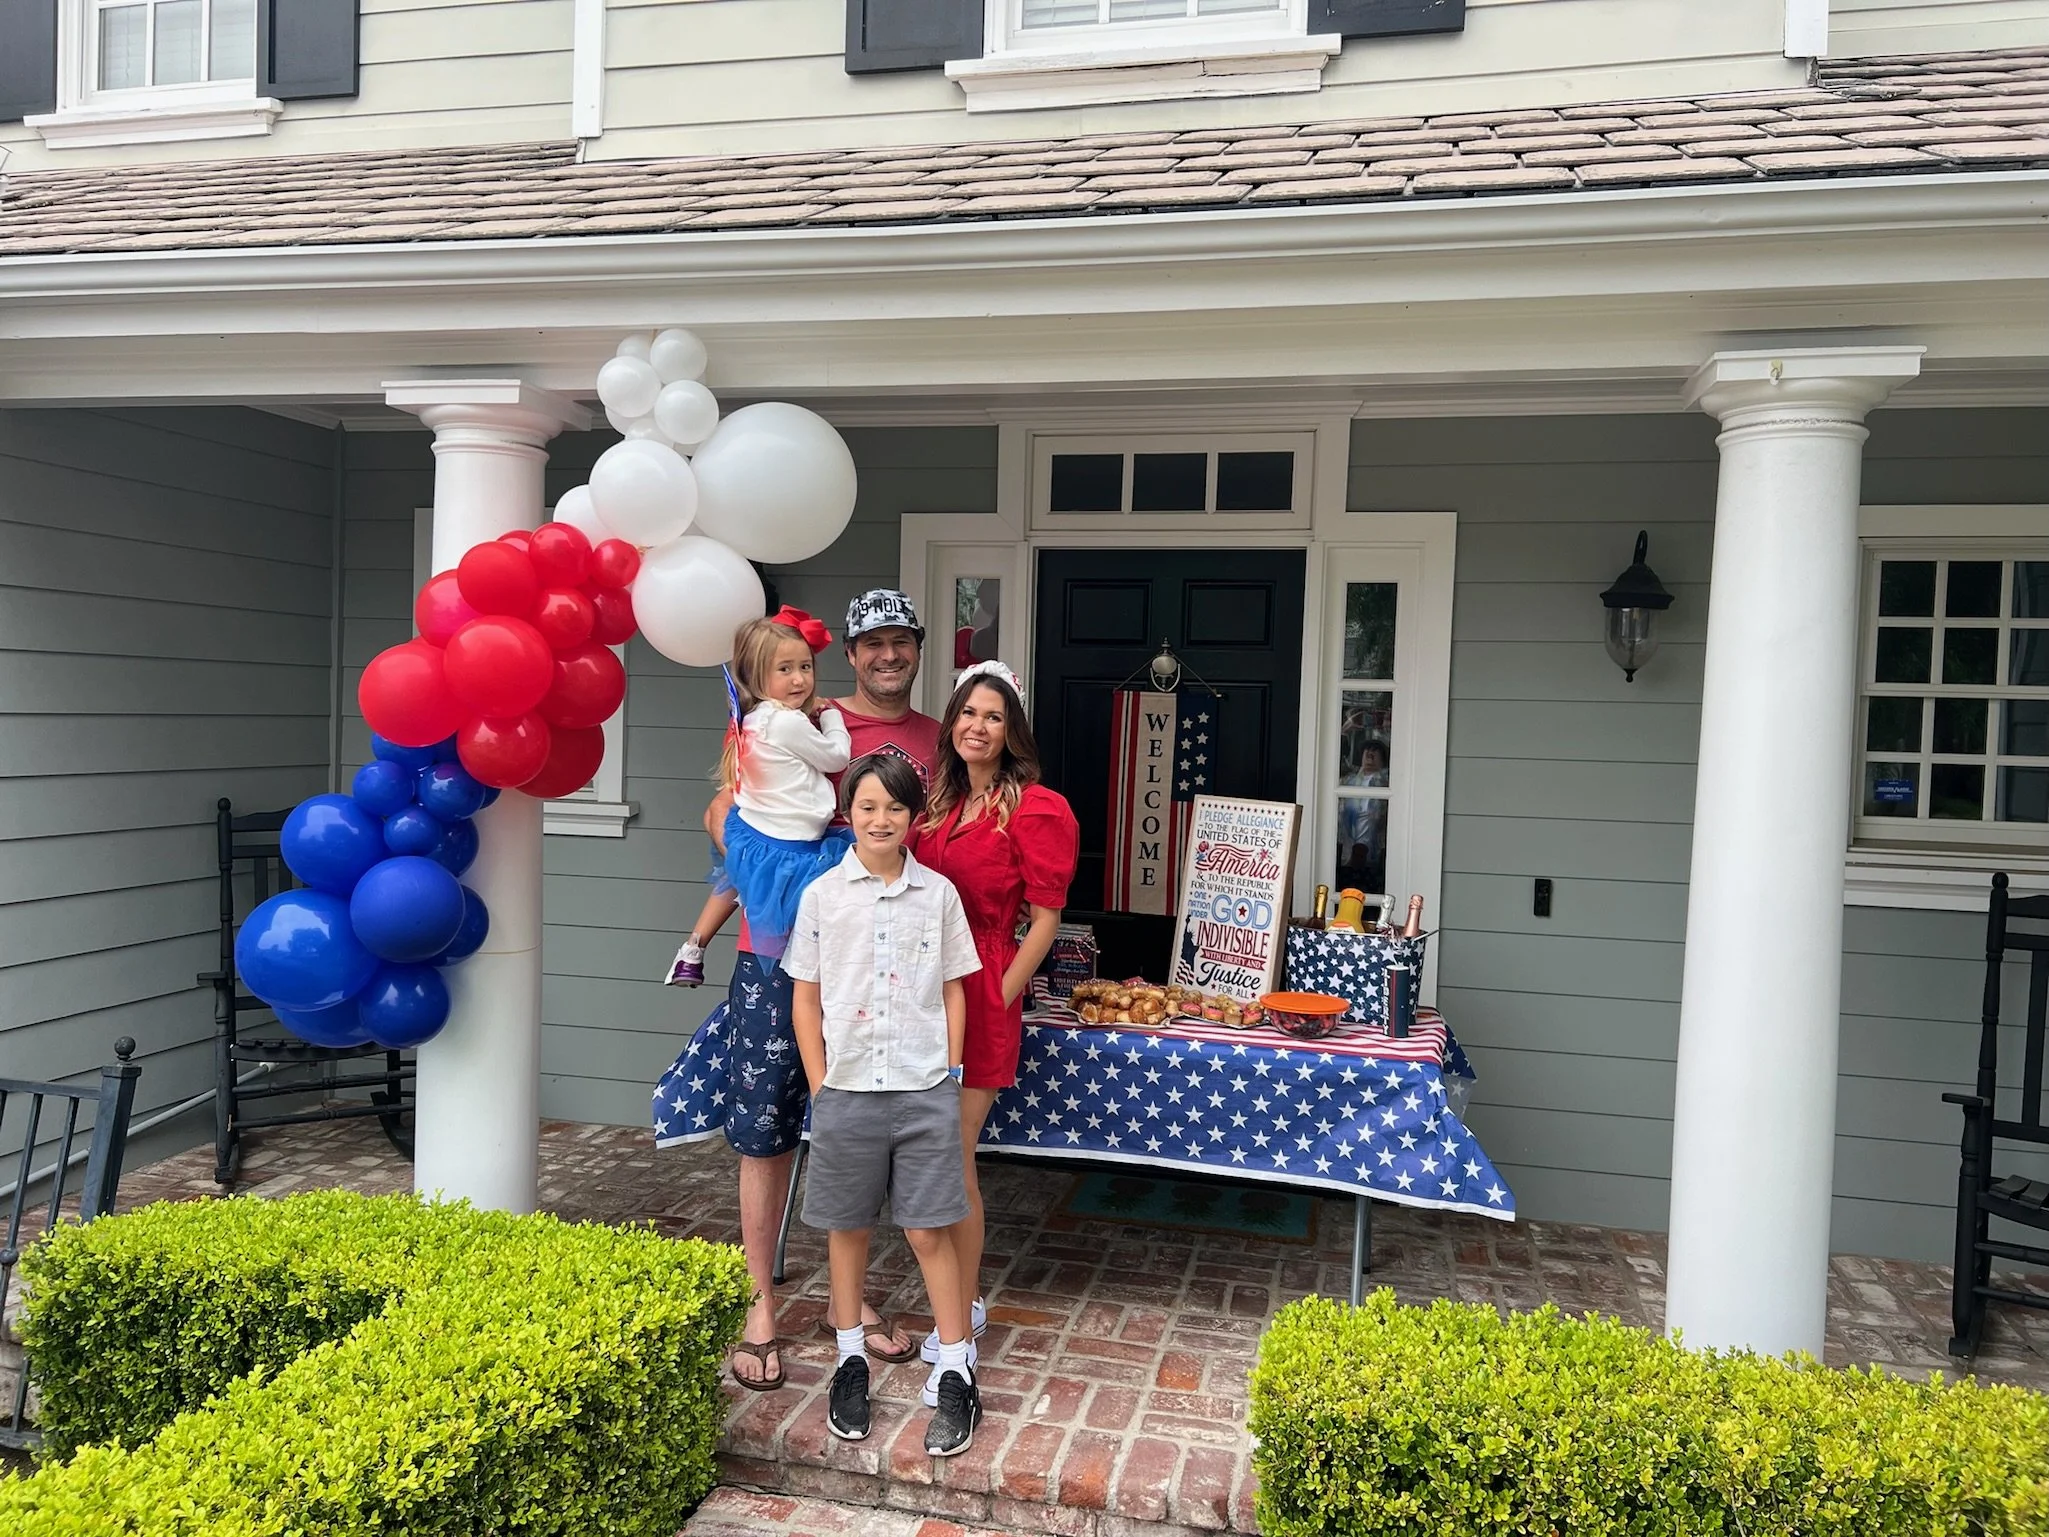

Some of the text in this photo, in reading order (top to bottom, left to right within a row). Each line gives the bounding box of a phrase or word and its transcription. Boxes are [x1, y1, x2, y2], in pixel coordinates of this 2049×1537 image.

[1138, 713, 1170, 886] WELCOME
[1204, 810, 1233, 824] PLEDGE
[1236, 814, 1284, 830] ALLEGIANCE
[1216, 824, 1228, 832] THE
[1231, 826, 1249, 834] FLAG
[1197, 829, 1282, 849] UNITED STATES OF
[1207, 848, 1280, 880] America
[1191, 880, 1274, 901] FOR WHICH IT STANDS
[1196, 871, 1274, 891] & TO THE REPUBLIC
[1211, 894, 1272, 930] GOD
[1197, 920, 1270, 959] INDIVISIBLE
[1205, 950, 1261, 969] WITH LIBERTY AND
[1196, 961, 1261, 990] Justice
[1218, 984, 1250, 999] FOR ALL
